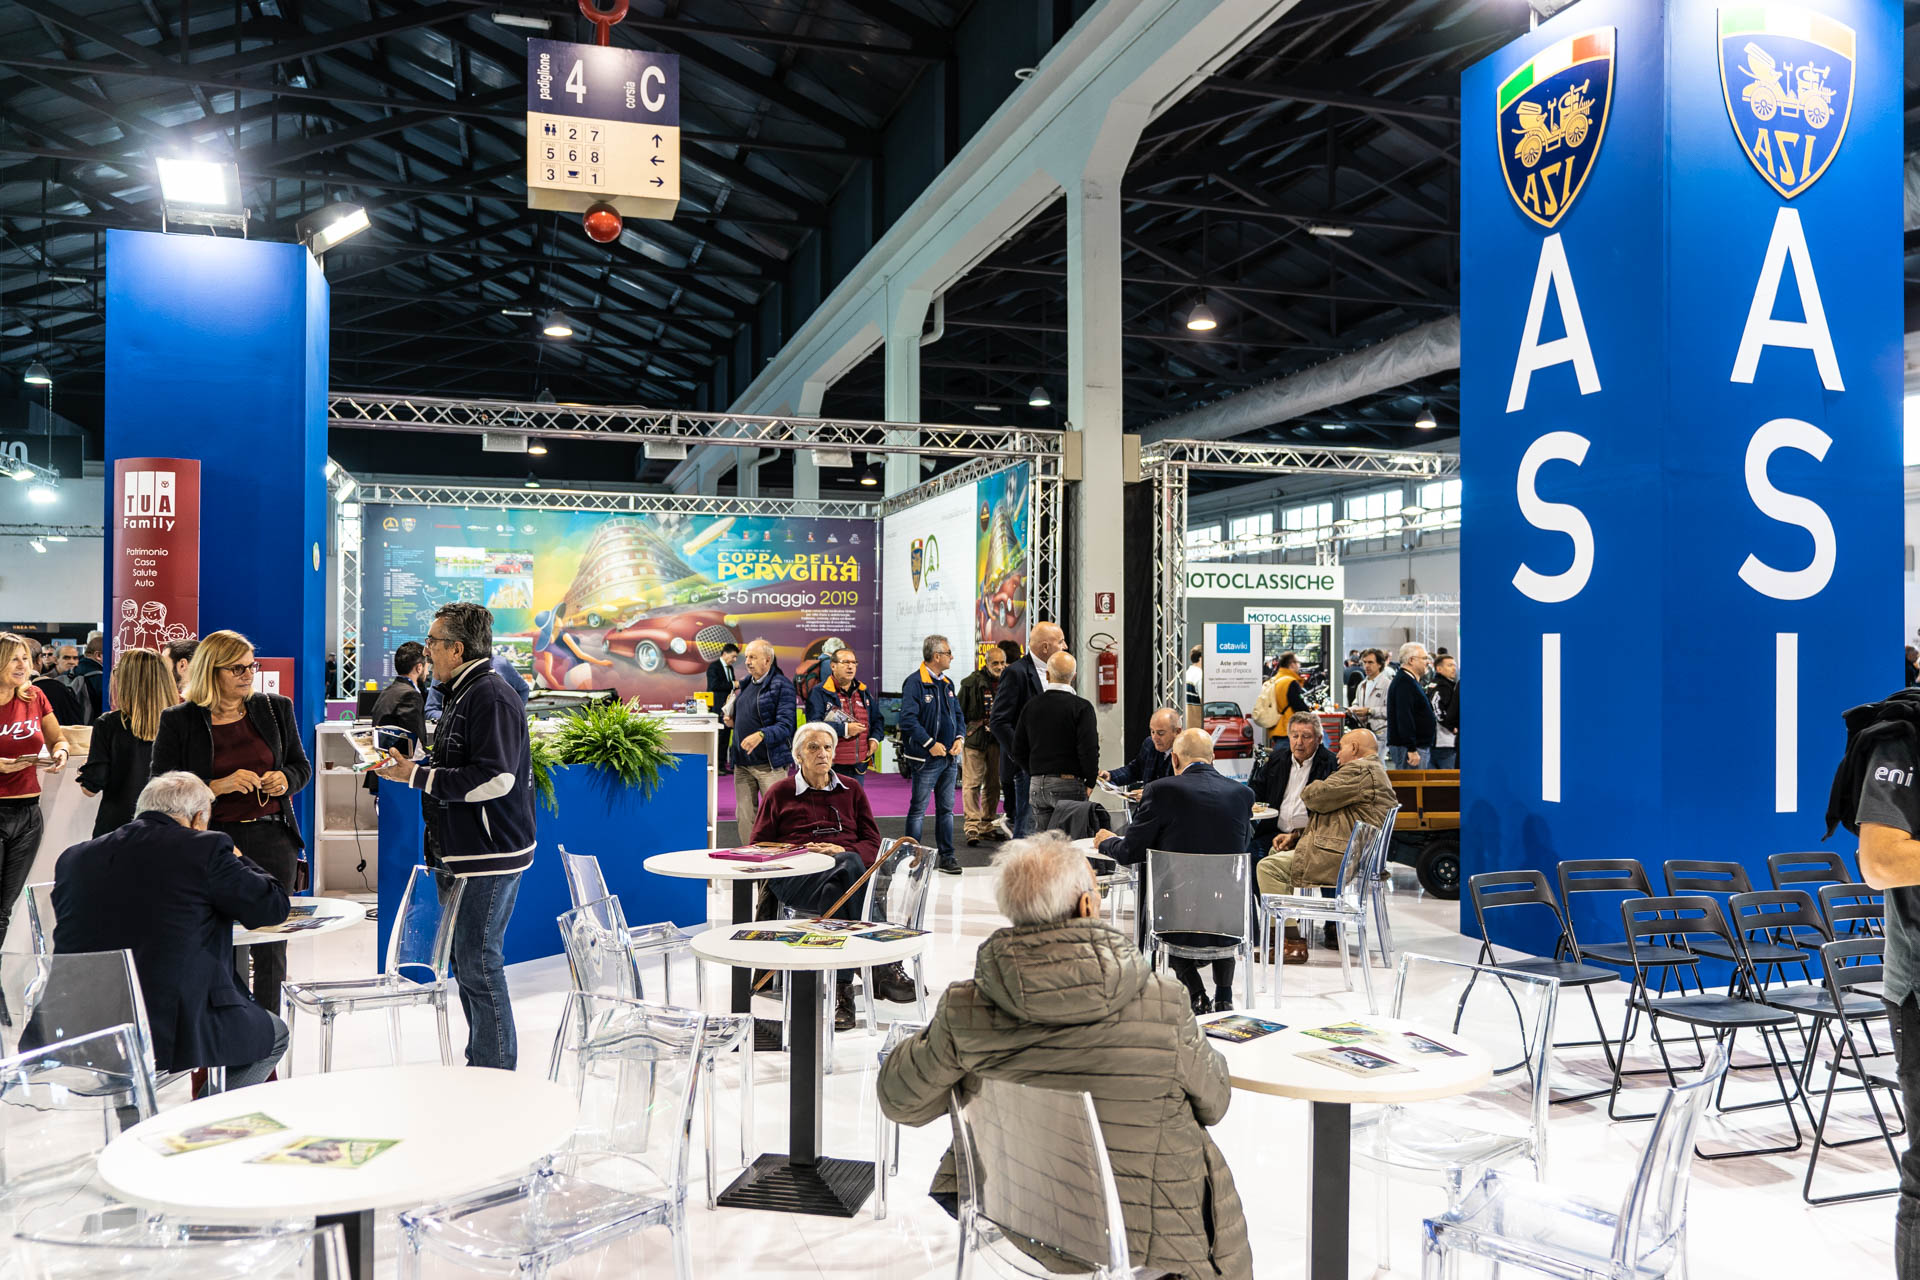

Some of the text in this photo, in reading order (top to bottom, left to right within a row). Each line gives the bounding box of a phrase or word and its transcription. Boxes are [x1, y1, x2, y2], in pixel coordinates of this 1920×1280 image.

[536, 53, 553, 100] padiglione
[565, 59, 587, 104] 4
[623, 81, 636, 109] corsia
[640, 65, 666, 112] C
[569, 128, 599, 142] 2 7
[546, 147, 599, 164] 5 6 8
[1753, 127, 1817, 186] ASI
[546, 168, 597, 185] 3 1
[1522, 155, 1576, 216] ASI
[127, 494, 171, 513] TUA
[1730, 206, 1846, 813] ASI
[123, 516, 176, 532] Family
[1506, 232, 1602, 803] ASI
[126, 547, 169, 557] Patrimonio
[717, 552, 783, 564] COPPA
[794, 553, 859, 565] DELLA
[134, 558, 156, 567] Casa
[132, 568, 158, 577] Salute
[134, 579, 155, 588] Auto
[717, 589, 859, 608] 3-5 maggio 2019
[1219, 640, 1248, 650] catawiki
[1874, 766, 1914, 787] eni
